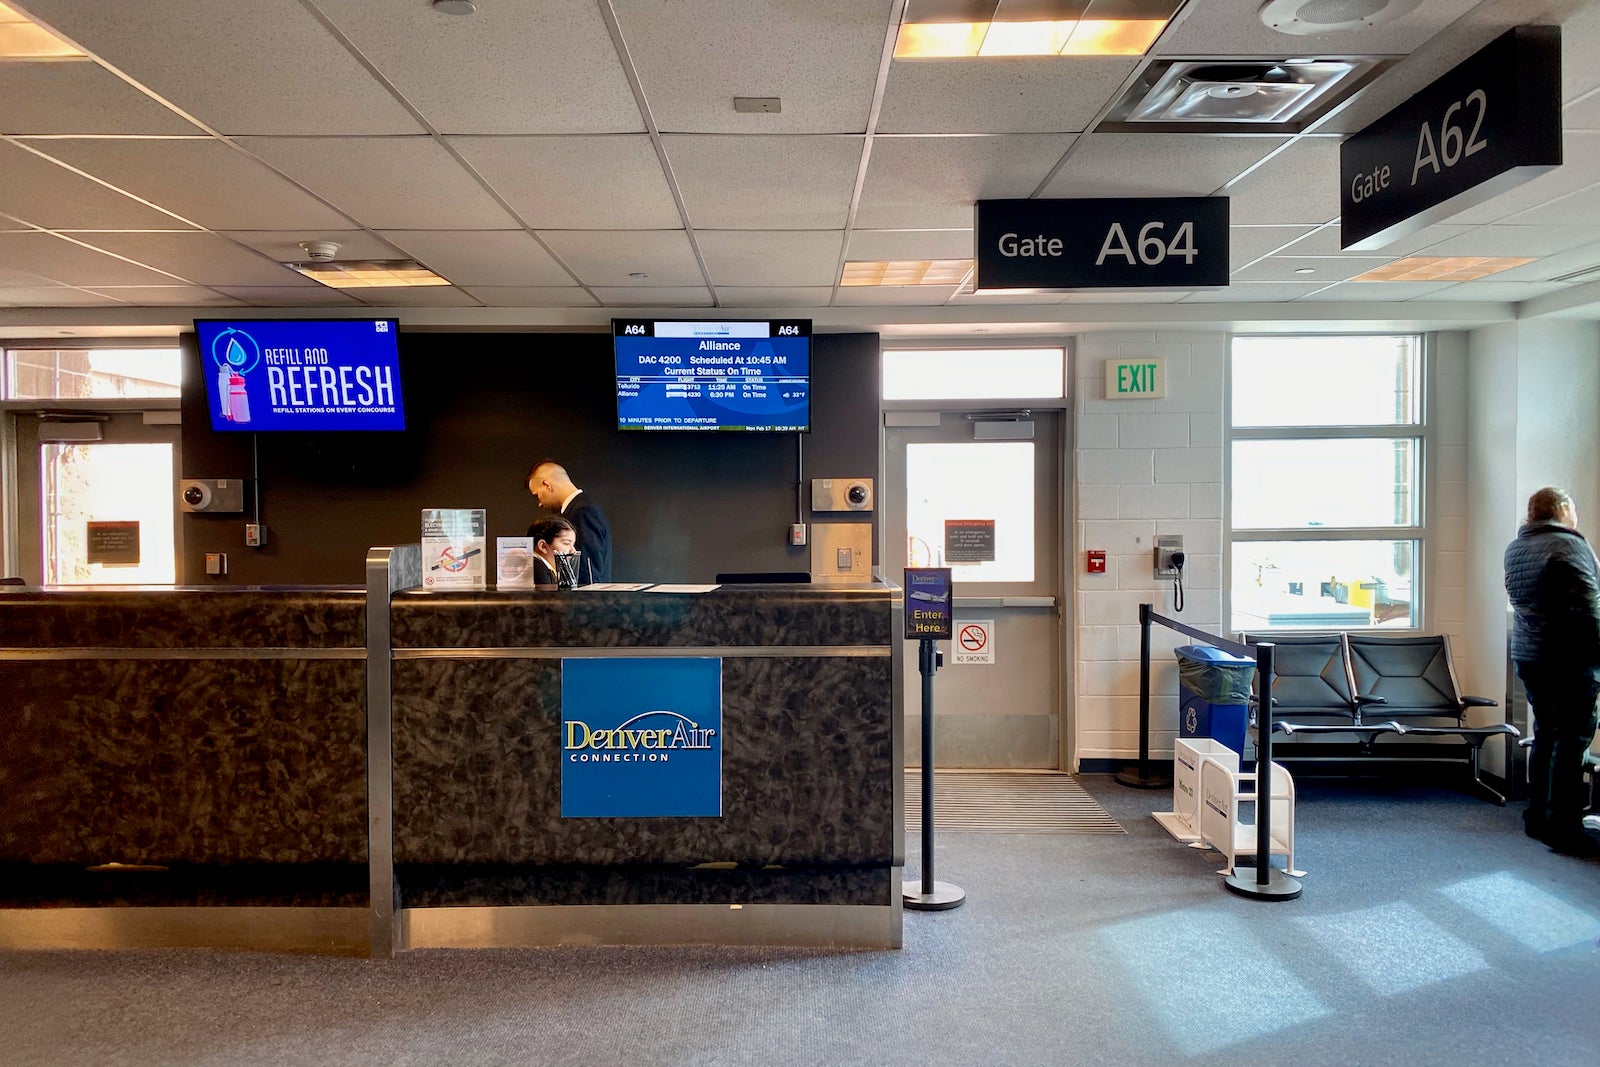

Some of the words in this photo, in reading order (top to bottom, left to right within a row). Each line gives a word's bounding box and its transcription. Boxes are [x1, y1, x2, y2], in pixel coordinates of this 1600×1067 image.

[1351, 164, 1391, 203] Gate
[1410, 88, 1488, 186] A62
[998, 233, 1064, 257] Gate
[1095, 221, 1198, 265] A64
[624, 325, 646, 334] A64
[778, 326, 799, 335] A64
[698, 340, 740, 350] Alliance
[265, 348, 302, 365] REFILL
[304, 348, 328, 365] AND
[638, 356, 657, 364] DAC
[658, 356, 682, 364] 4200
[690, 356, 733, 364] Scheduled
[734, 356, 745, 364] At
[746, 356, 772, 364] 10:45
[772, 356, 786, 364] AM
[664, 367, 695, 376] Current
[696, 367, 726, 376] Status:
[727, 367, 740, 376] On
[740, 367, 762, 376] Time
[1117, 364, 1157, 392] EXIT
[268, 366, 394, 406] REFRESH
[914, 610, 942, 619] Enter
[916, 623, 940, 632] Here
[564, 719, 716, 750] DenverAir
[570, 754, 669, 762] CONNECTION
